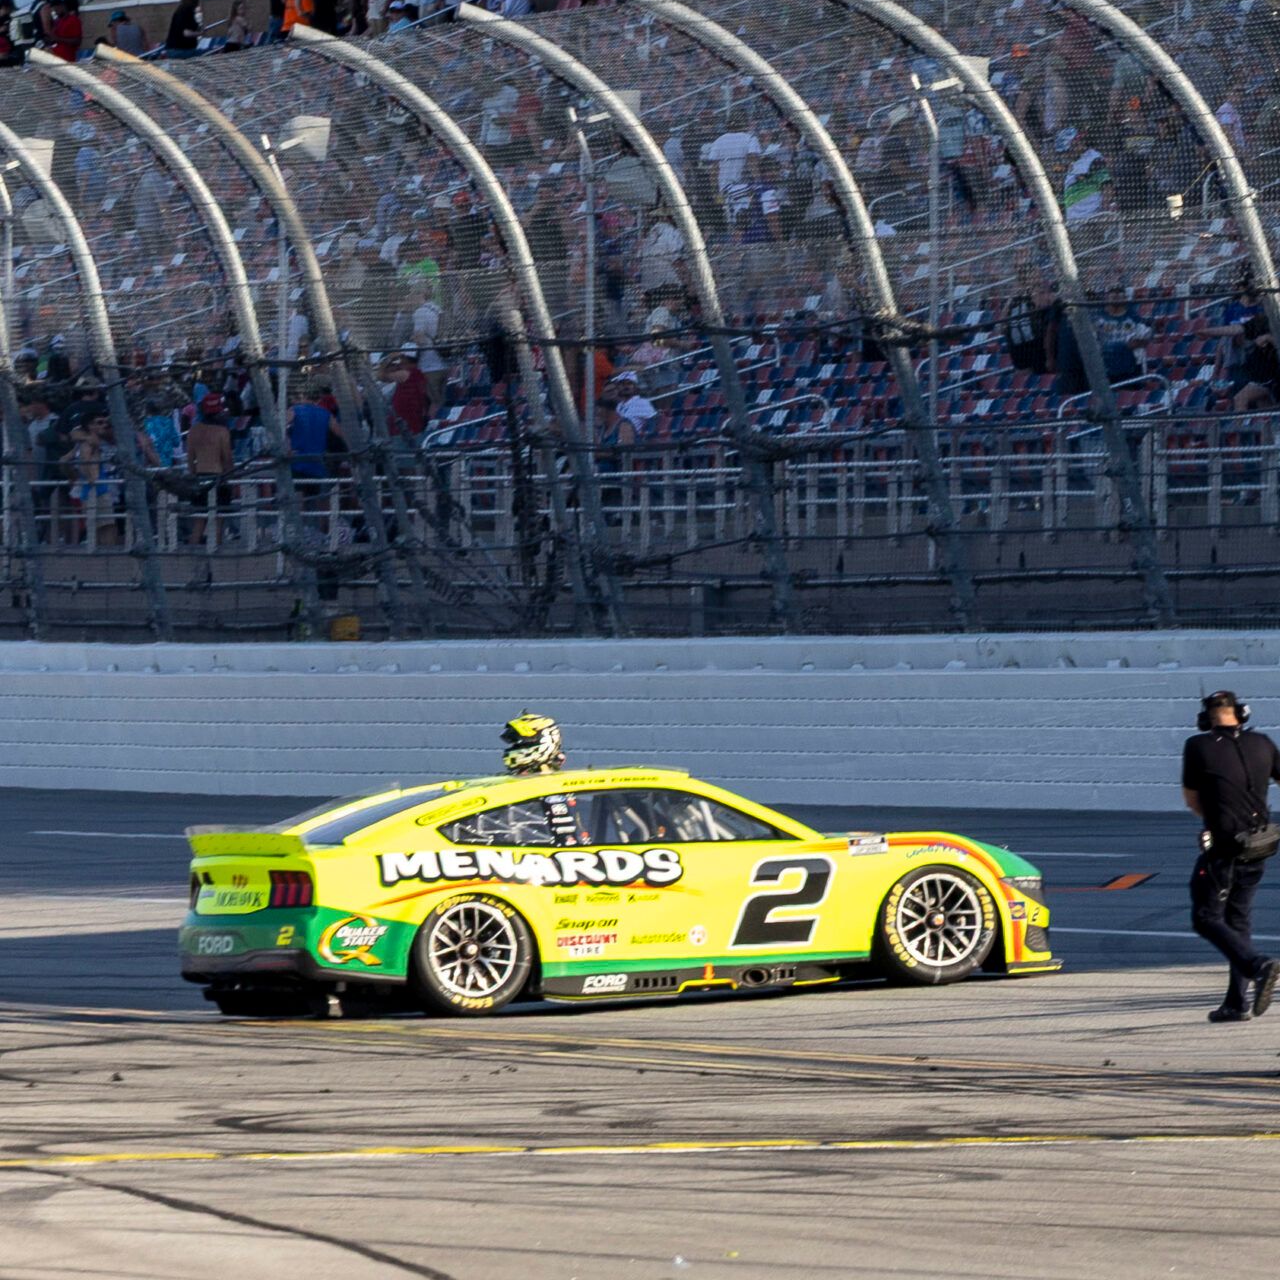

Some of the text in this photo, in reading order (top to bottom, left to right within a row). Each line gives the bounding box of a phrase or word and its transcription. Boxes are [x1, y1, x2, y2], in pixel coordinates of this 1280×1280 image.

[376, 848, 684, 888] MENARDS
[729, 854, 837, 949] 2
[276, 925, 295, 946] 2
[335, 925, 388, 938] QUAKER
[198, 935, 234, 954] FORD
[342, 935, 377, 947] STATE
[557, 933, 618, 947] DISCOUNT
[573, 946, 600, 954] TIRE
[584, 973, 628, 988] FORD
